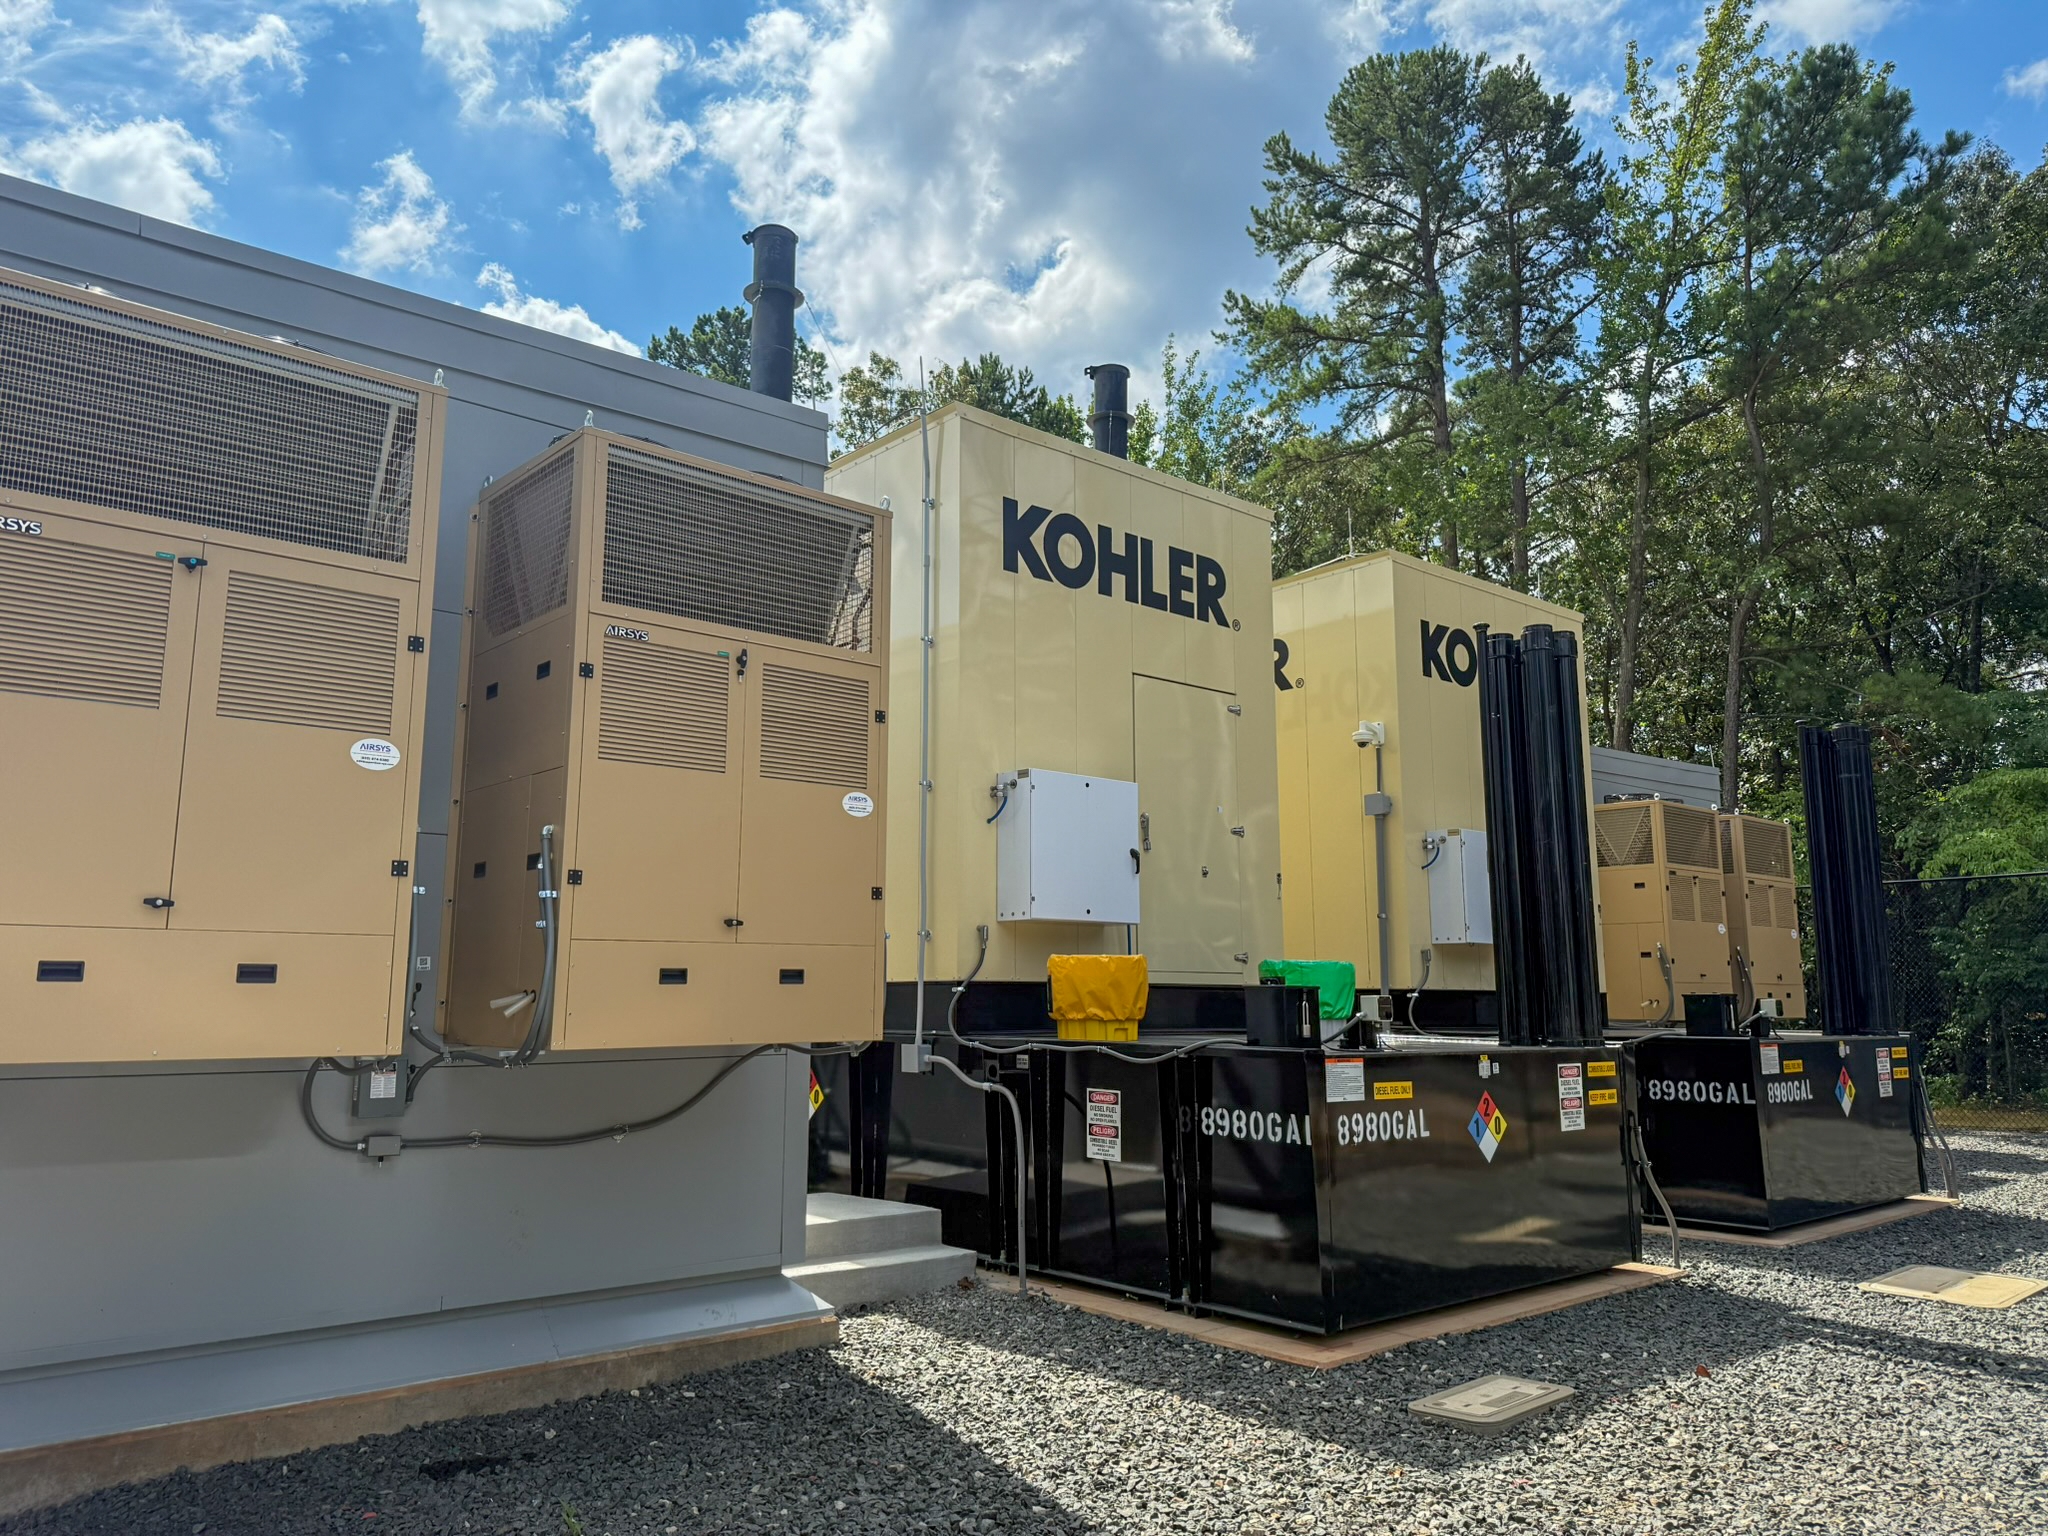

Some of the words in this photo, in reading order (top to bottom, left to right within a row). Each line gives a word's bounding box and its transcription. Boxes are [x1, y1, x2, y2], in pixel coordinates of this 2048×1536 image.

[605, 625, 649, 641] AIRSYS
[360, 743, 391, 752] AIRSYS
[1092, 1093, 1115, 1102] DANGER
[1649, 1079, 1757, 1105] 8980GAL
[1767, 1079, 1814, 1104] 8980GAL
[1090, 1104, 1105, 1113] DIESEL
[1106, 1106, 1117, 1114] FUEL
[1483, 1097, 1490, 1117] 2
[1093, 1126, 1115, 1136] PELIGRO
[1337, 1108, 1430, 1146] 8980GAL
[1474, 1117, 1480, 1137] 1
[1494, 1116, 1501, 1135] 0
